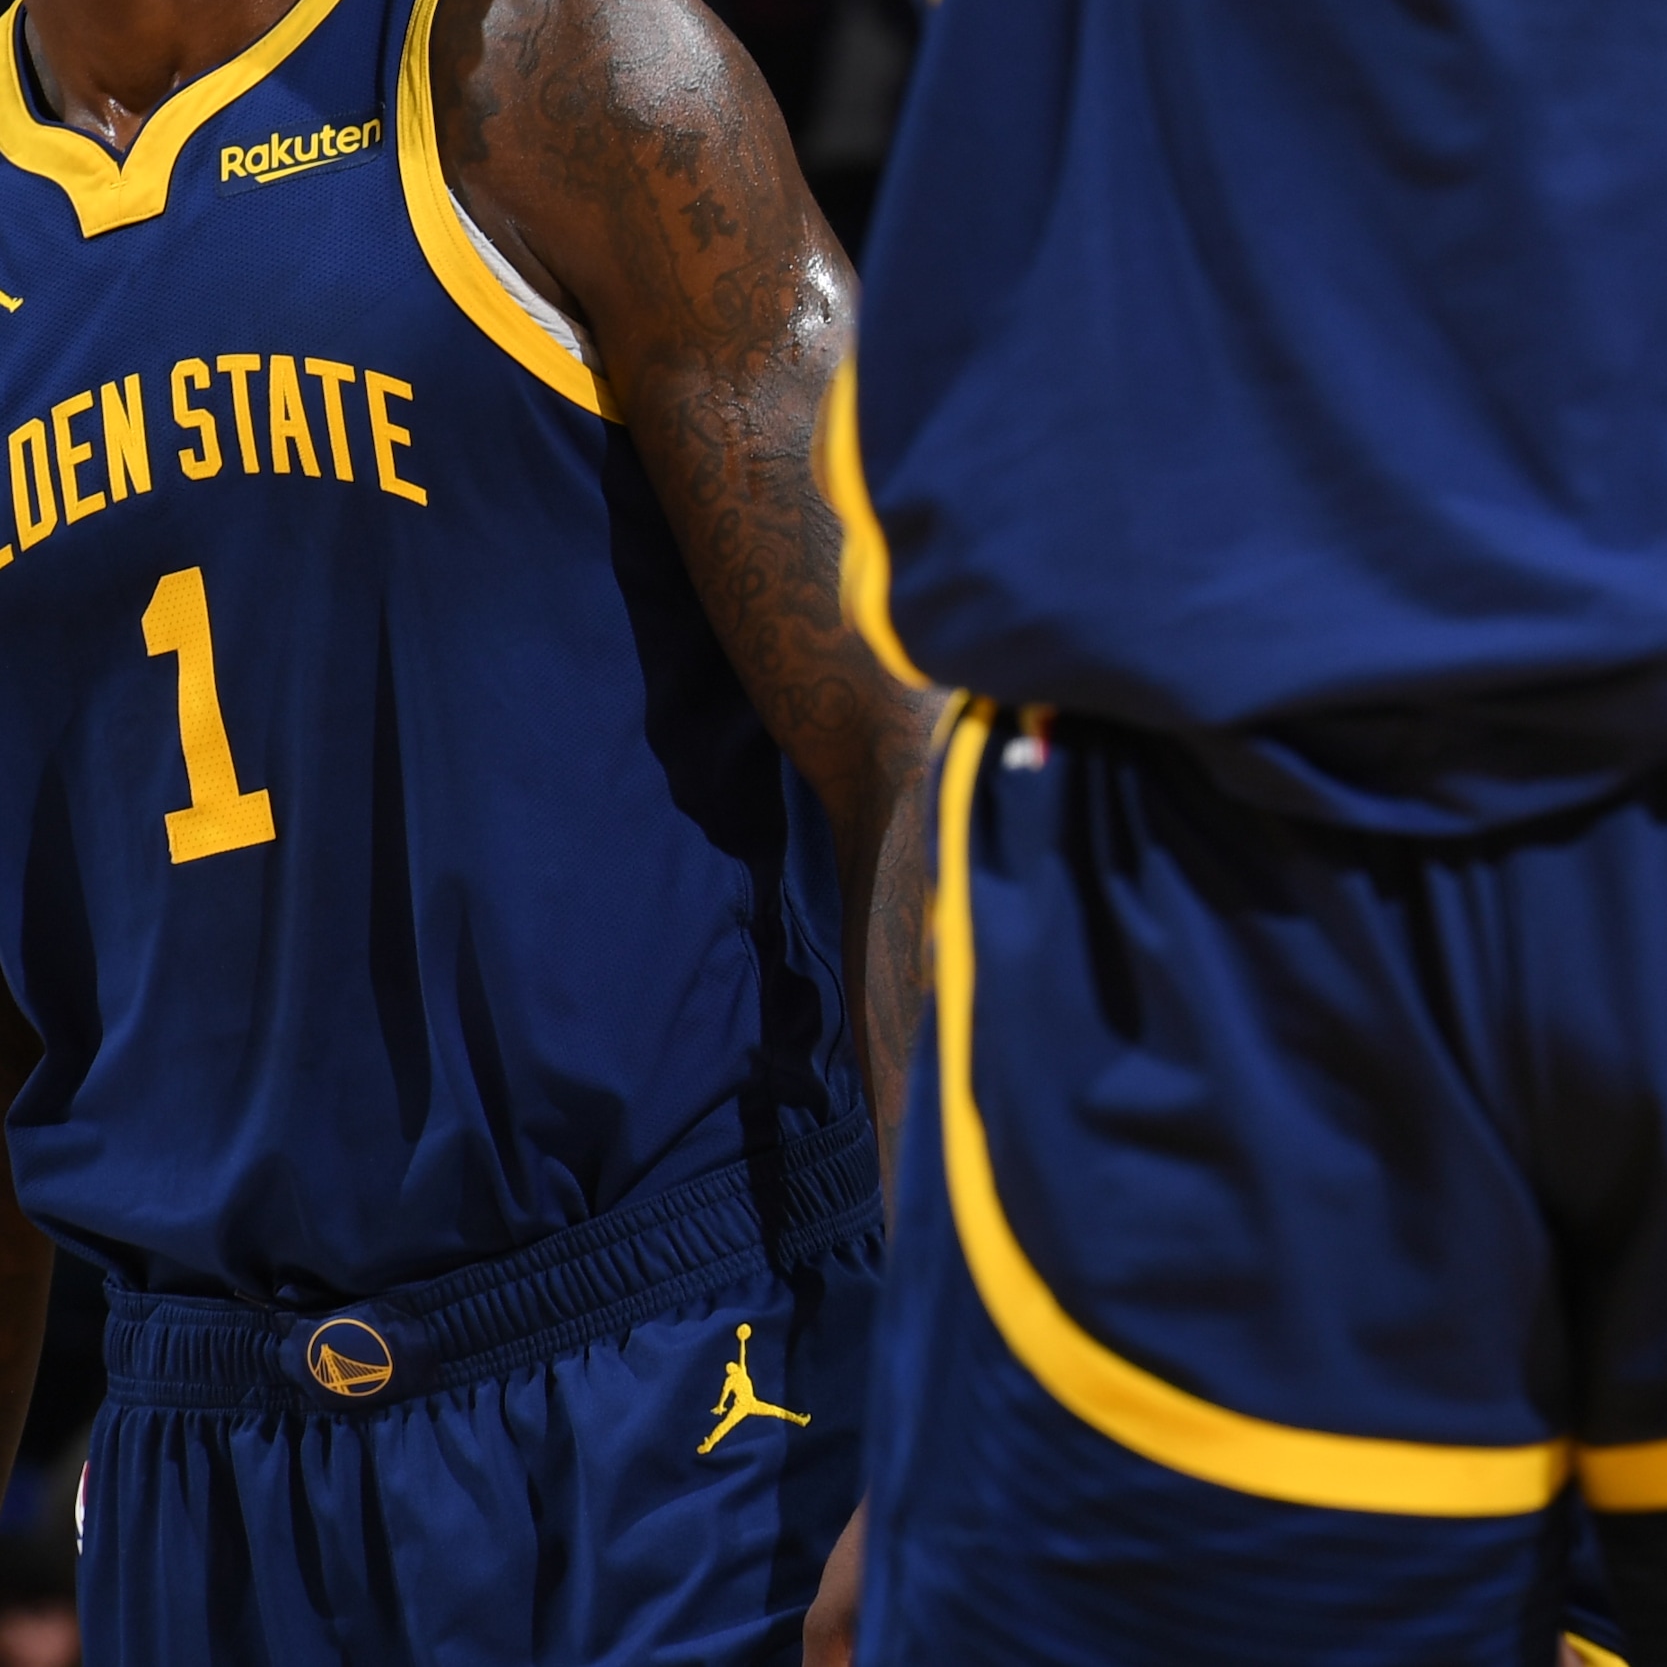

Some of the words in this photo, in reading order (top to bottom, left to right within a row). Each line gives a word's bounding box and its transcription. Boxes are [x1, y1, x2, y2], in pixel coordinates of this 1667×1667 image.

[219, 117, 382, 184] Rakuten
[0, 372, 153, 570] DEN
[169, 352, 429, 508] STATE
[140, 565, 277, 866] 1
